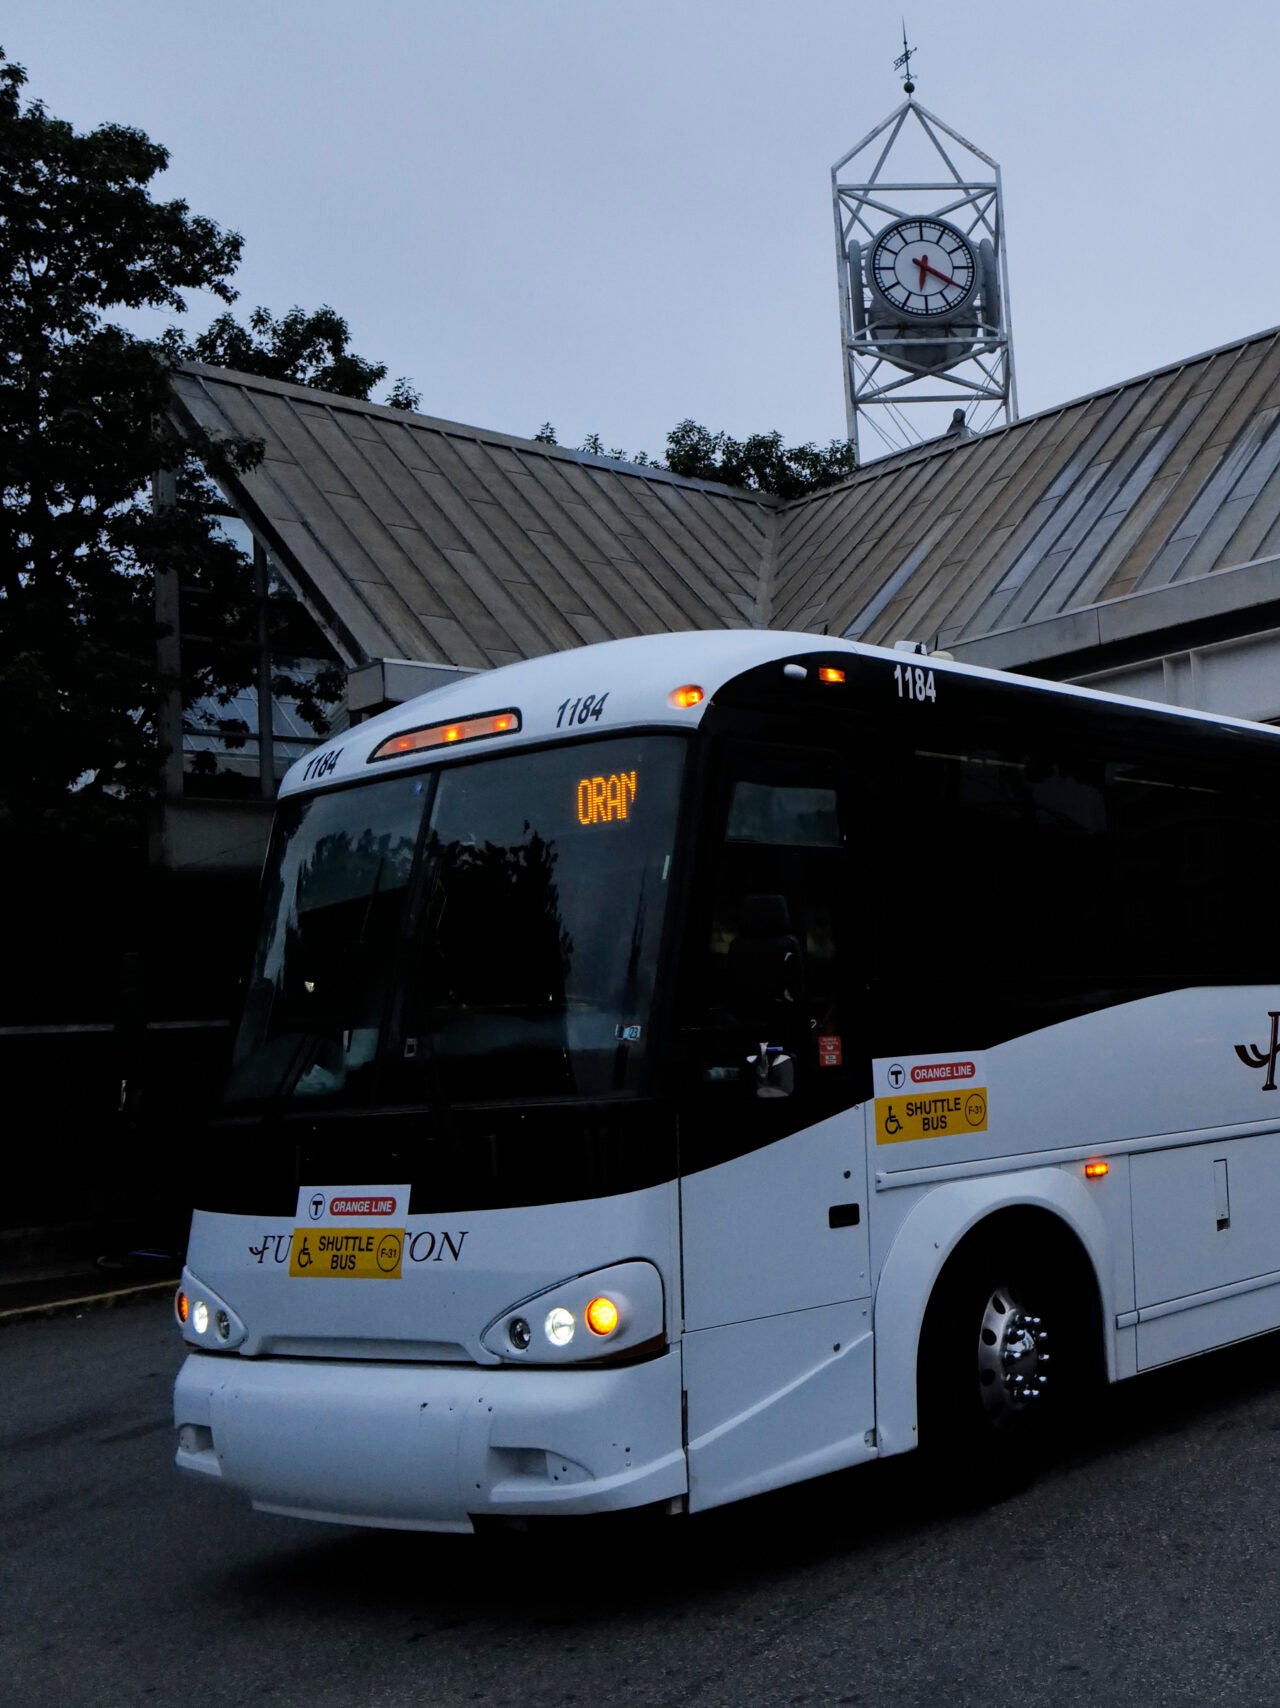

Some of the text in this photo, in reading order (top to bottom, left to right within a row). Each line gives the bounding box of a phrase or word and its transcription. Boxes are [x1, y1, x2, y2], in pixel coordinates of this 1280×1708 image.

[894, 664, 937, 703] 1184
[555, 692, 610, 728] 1184
[302, 747, 344, 782] 1184
[577, 769, 637, 824] ORAN
[914, 1065, 972, 1080] ORANGE LINE
[906, 1097, 961, 1117] SHUTTLE
[968, 1105, 983, 1115] F-31
[922, 1115, 947, 1131] BUS
[333, 1200, 393, 1213] ORANGE LINE
[318, 1236, 375, 1252] SHUTTLE
[380, 1248, 397, 1258] F-31
[330, 1255, 356, 1270] BUS
